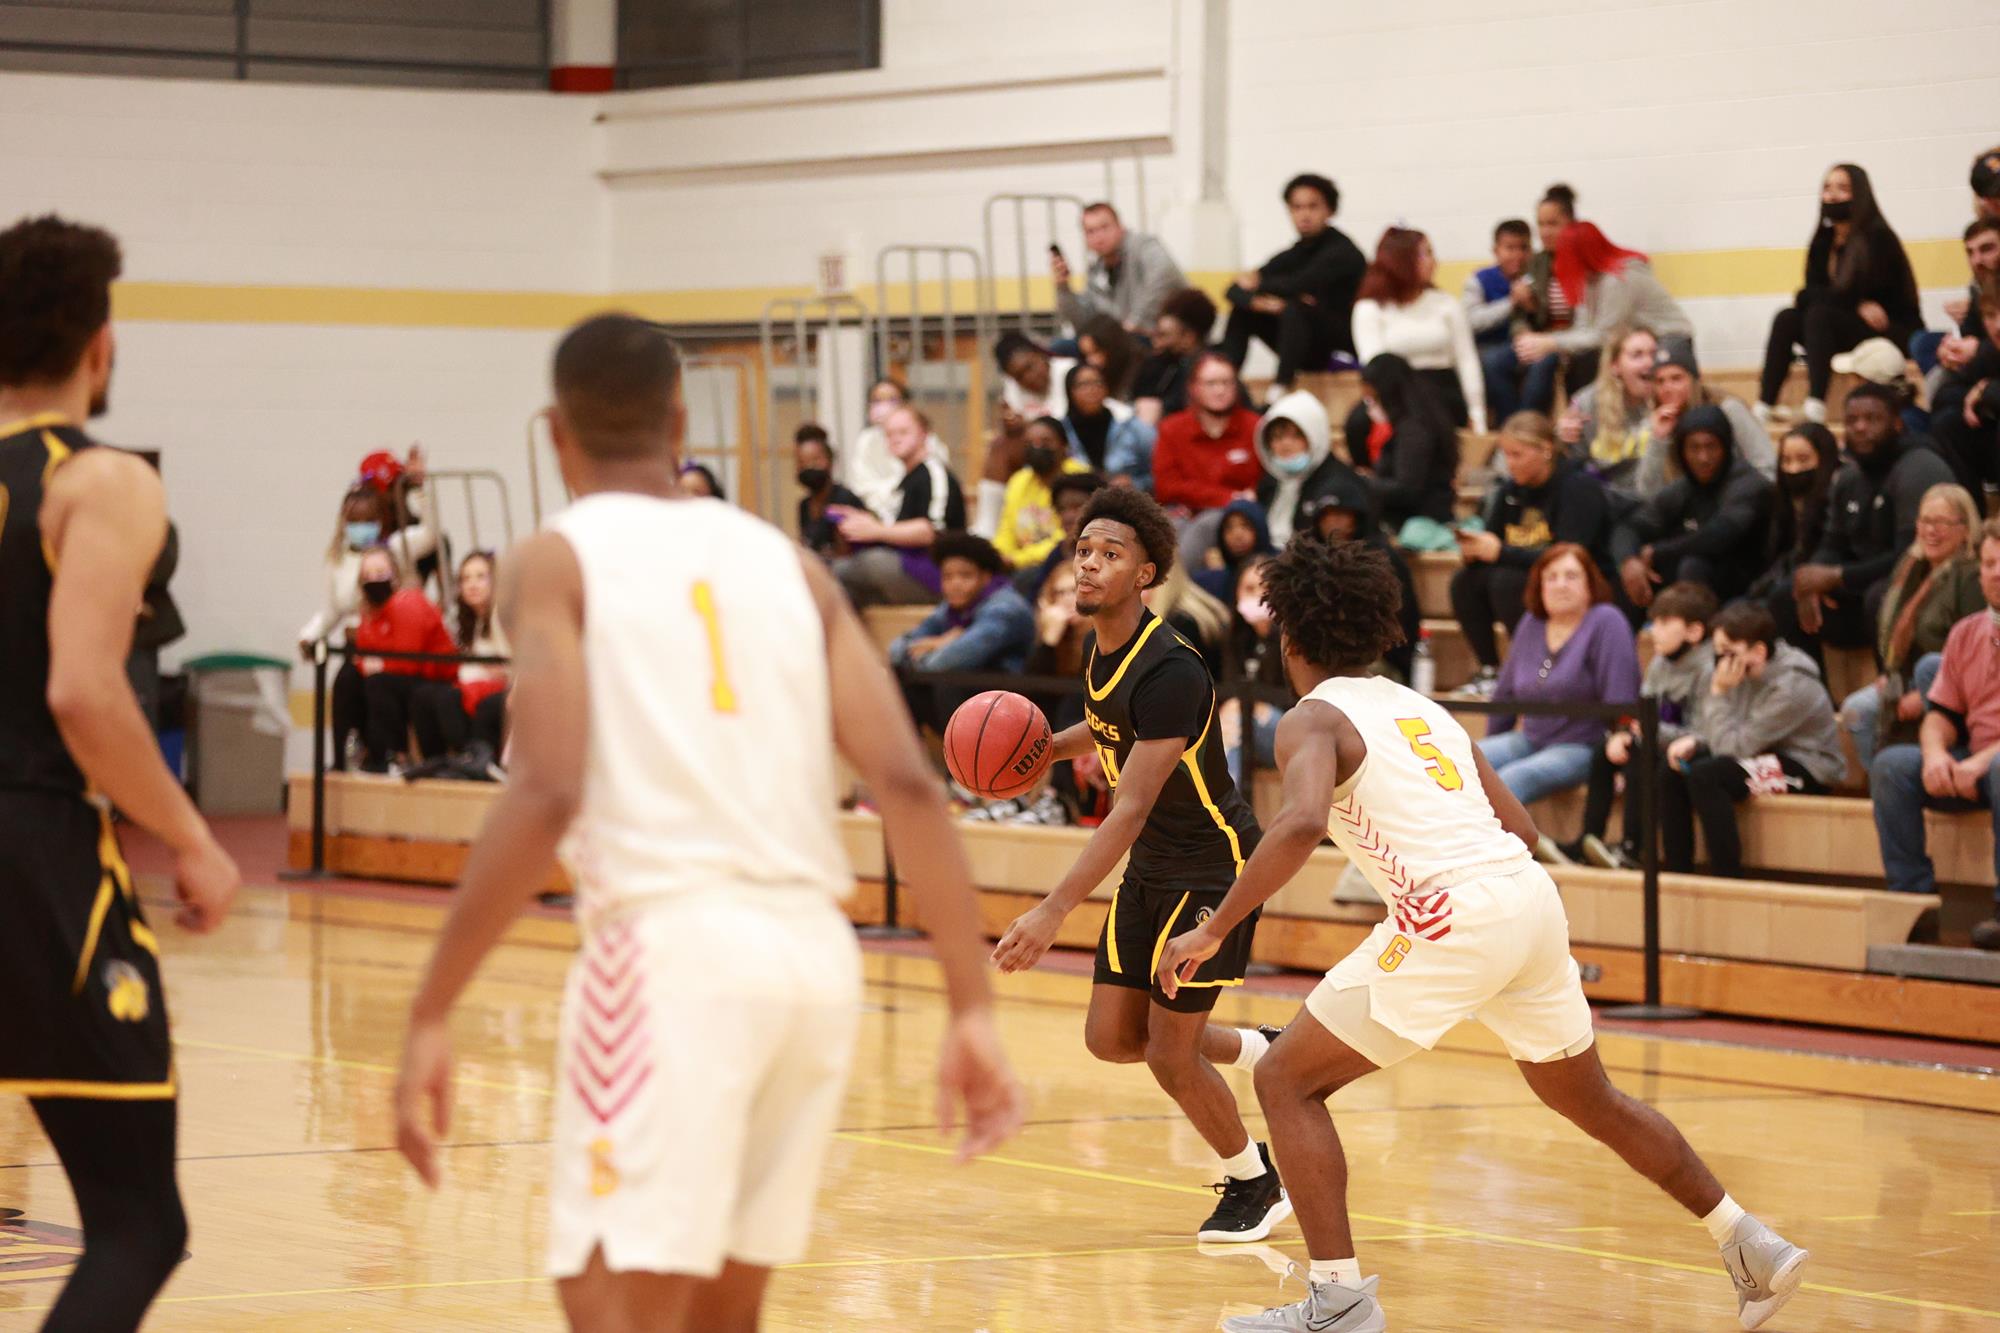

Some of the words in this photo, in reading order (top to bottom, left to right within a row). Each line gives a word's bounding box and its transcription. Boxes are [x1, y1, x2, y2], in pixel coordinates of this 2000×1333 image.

[692, 580, 738, 713] 1
[1393, 716, 1464, 791] 5
[1377, 934, 1412, 973] G
